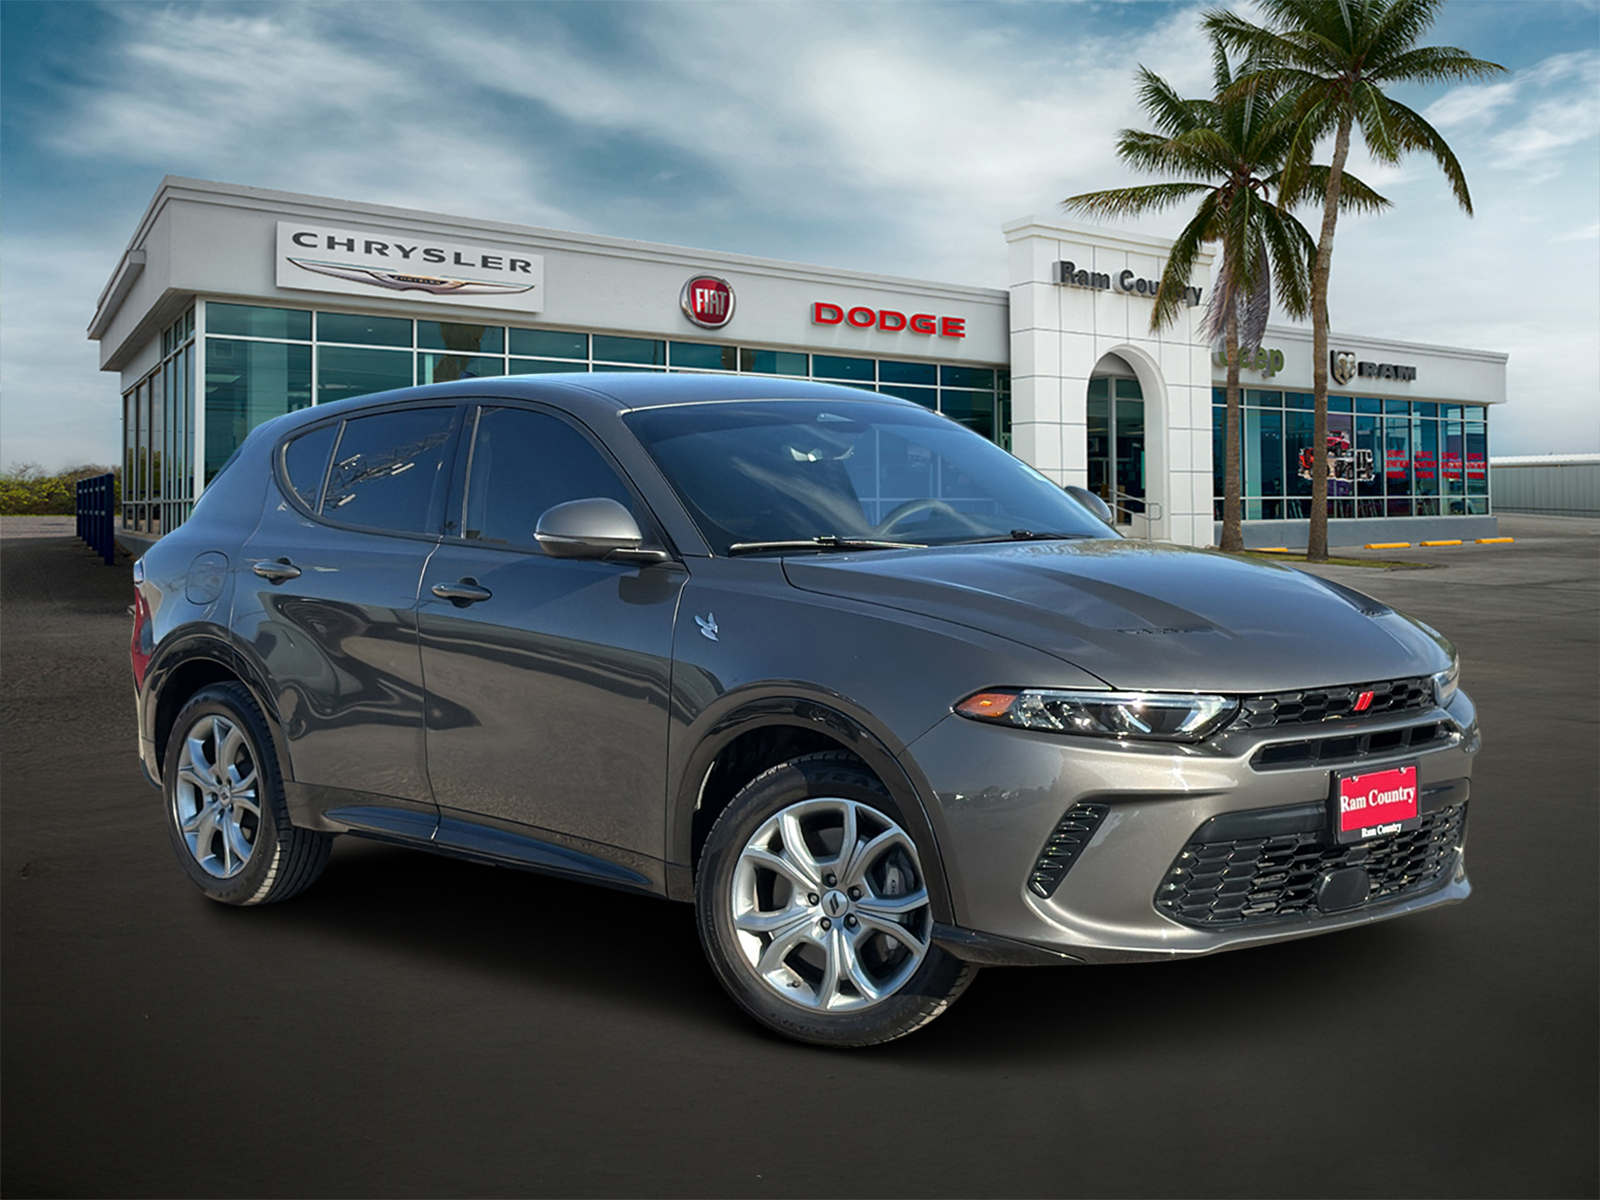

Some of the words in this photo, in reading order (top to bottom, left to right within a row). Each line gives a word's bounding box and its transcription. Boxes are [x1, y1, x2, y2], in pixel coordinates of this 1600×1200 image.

[291, 232, 532, 274] CHRYSLER
[1053, 260, 1111, 290] Ram
[1113, 269, 1203, 306] Coury
[695, 288, 728, 315] FIAT
[811, 301, 966, 338] DODGE
[1358, 361, 1417, 381] RAM
[1340, 795, 1367, 813] Ram
[1368, 786, 1415, 806] Country
[1361, 827, 1377, 838] Ram
